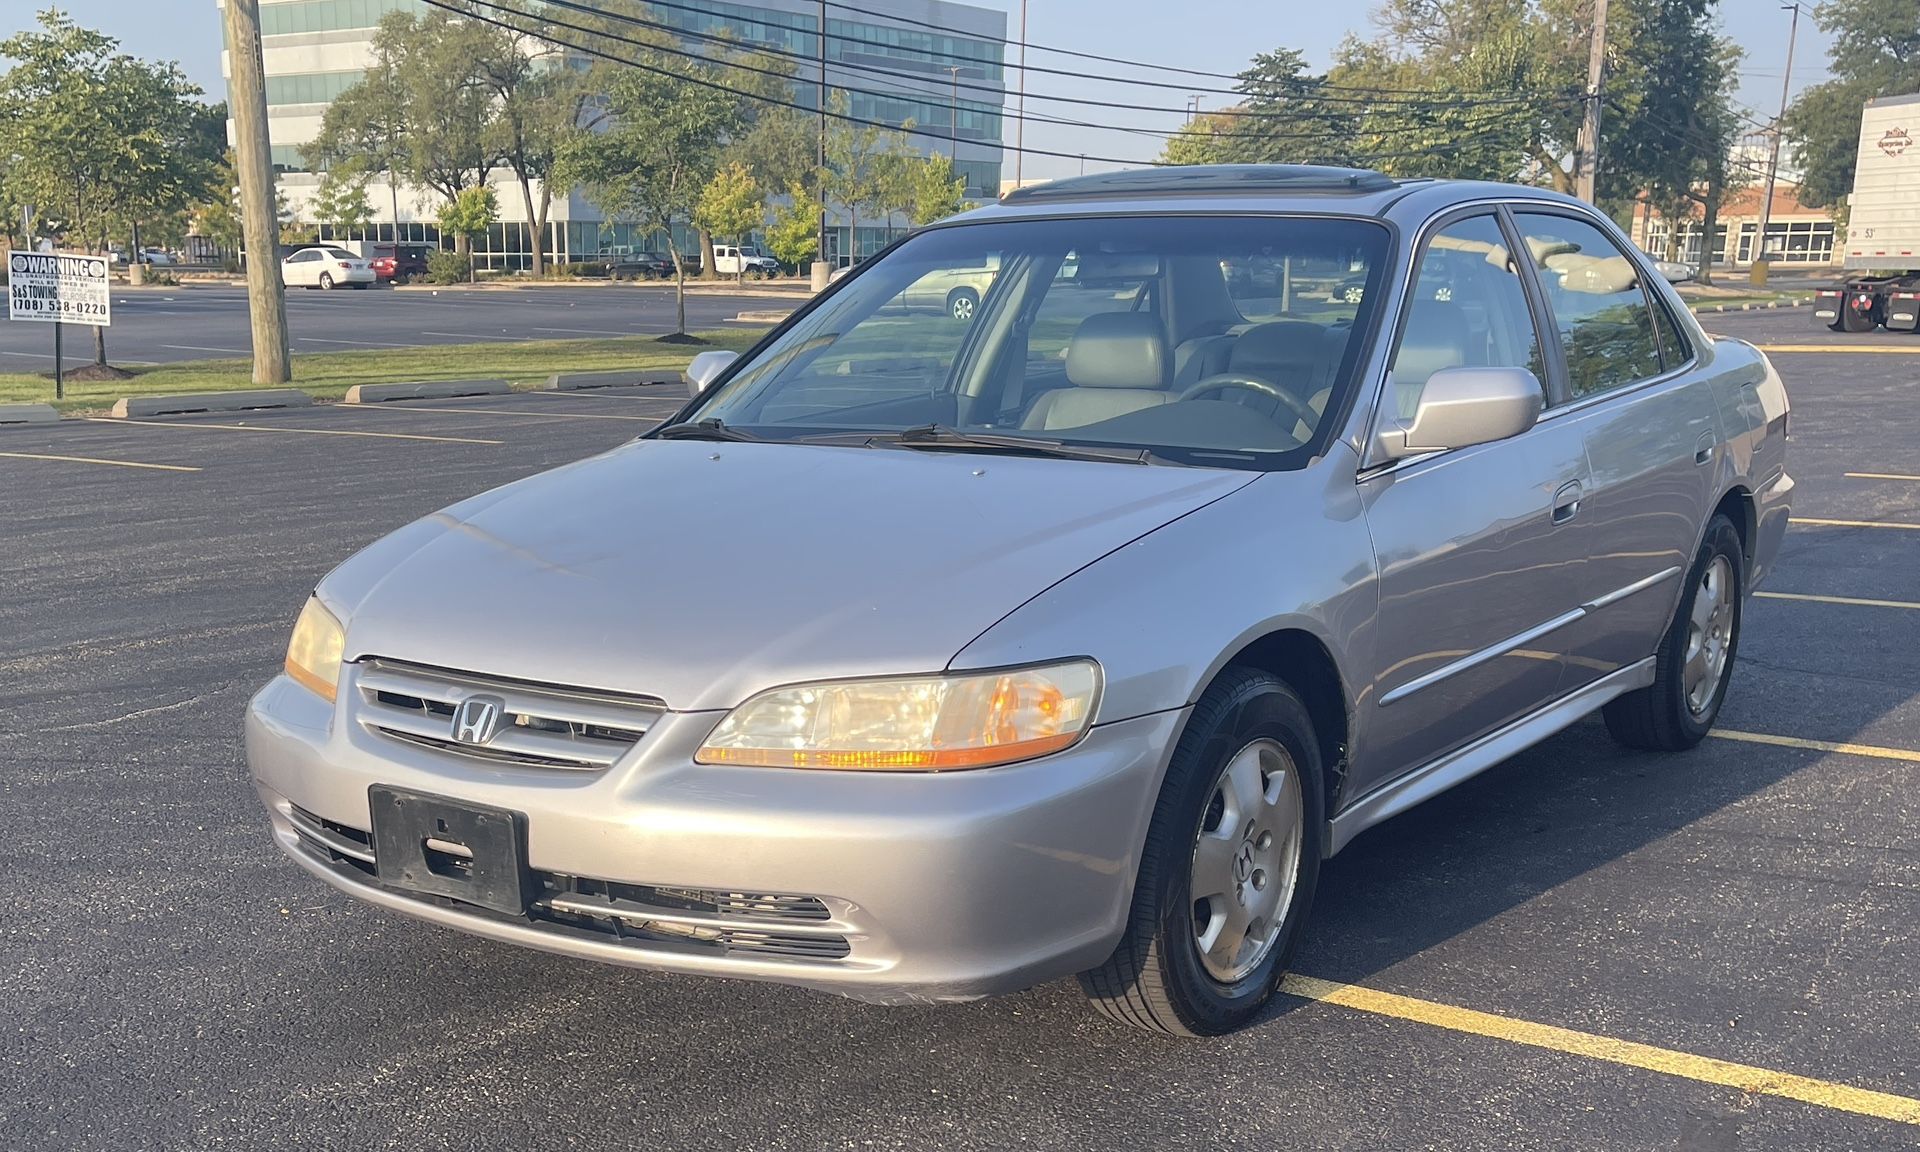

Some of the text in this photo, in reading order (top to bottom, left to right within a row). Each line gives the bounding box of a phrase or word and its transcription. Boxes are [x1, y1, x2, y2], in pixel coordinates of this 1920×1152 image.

[27, 256, 89, 276] WARNING
[26, 273, 72, 281] UNAUTHORIZED
[12, 285, 28, 298] S&S
[28, 285, 57, 299] TOWING
[13, 299, 107, 315] (708) 538-0220
